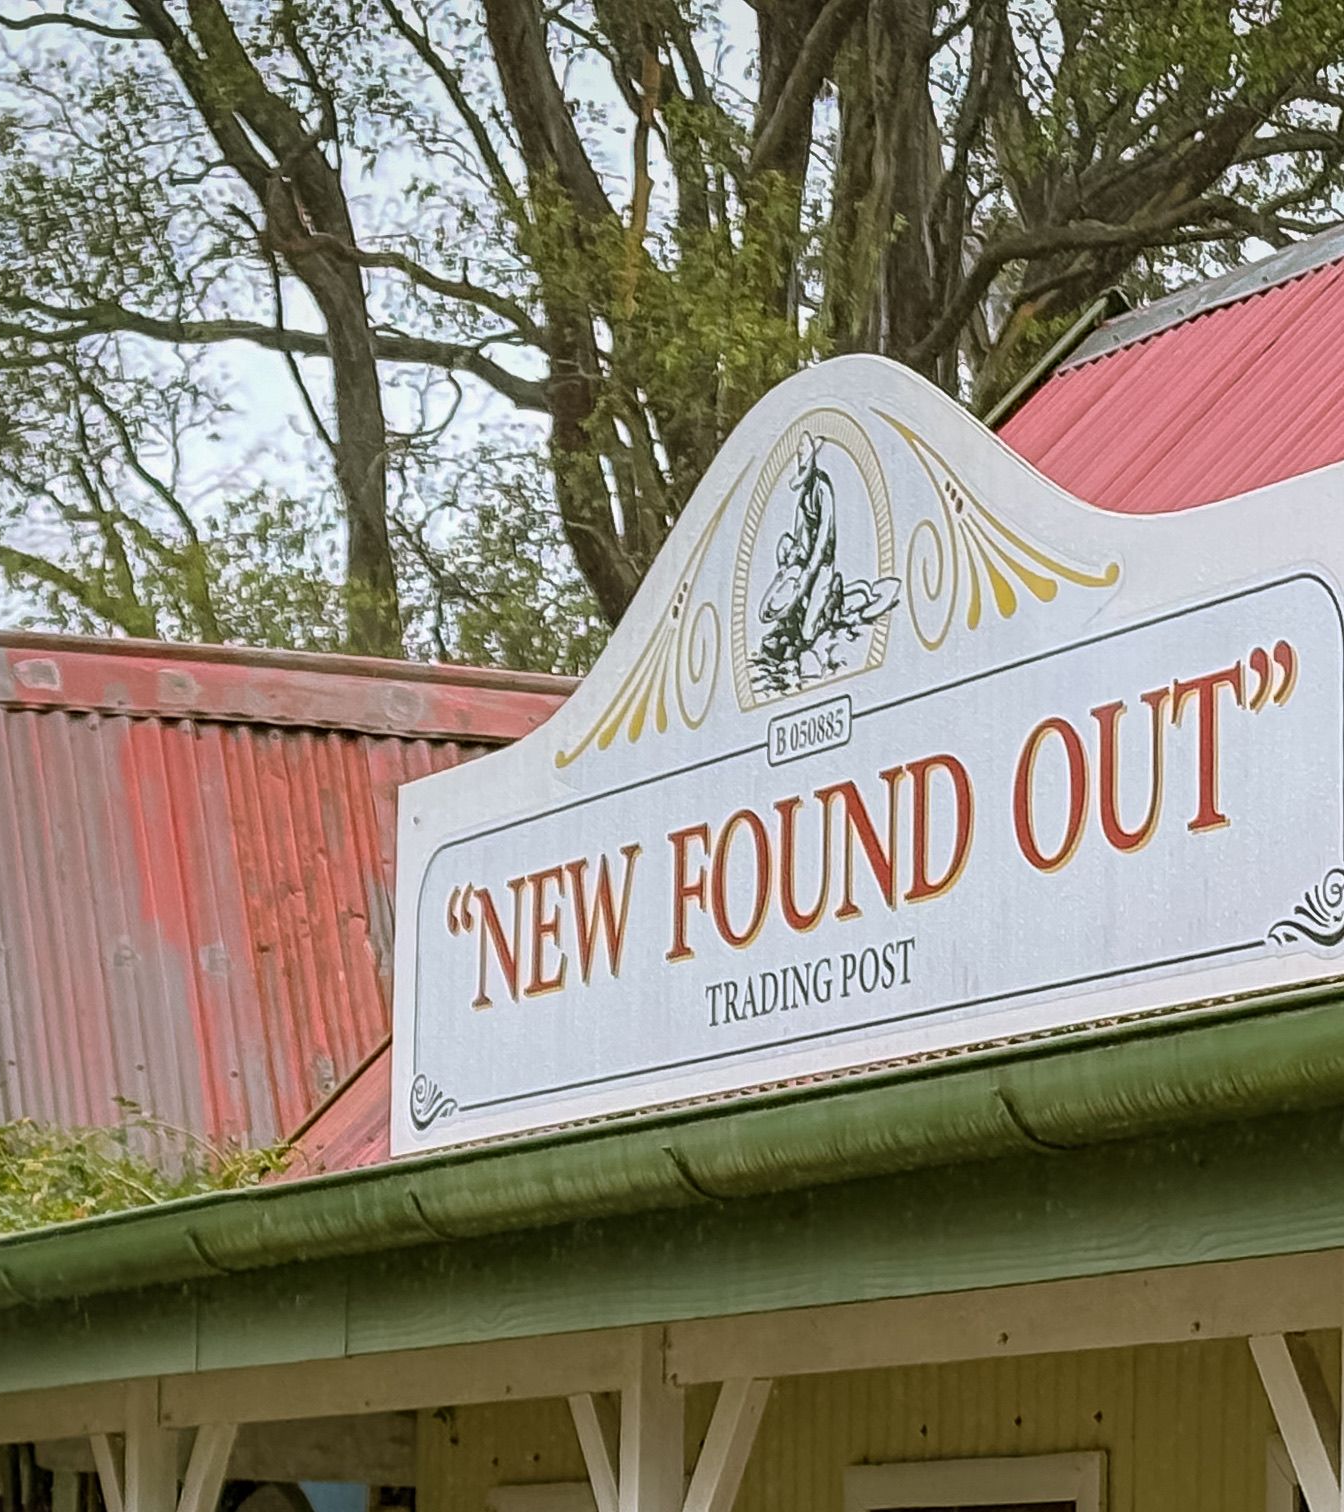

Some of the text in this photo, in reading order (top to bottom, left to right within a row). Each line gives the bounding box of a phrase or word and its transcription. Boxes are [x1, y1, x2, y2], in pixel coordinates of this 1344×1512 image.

[776, 708, 844, 755] B 050885
[666, 754, 973, 963] FOUND
[704, 938, 916, 1028] TRADING POST
